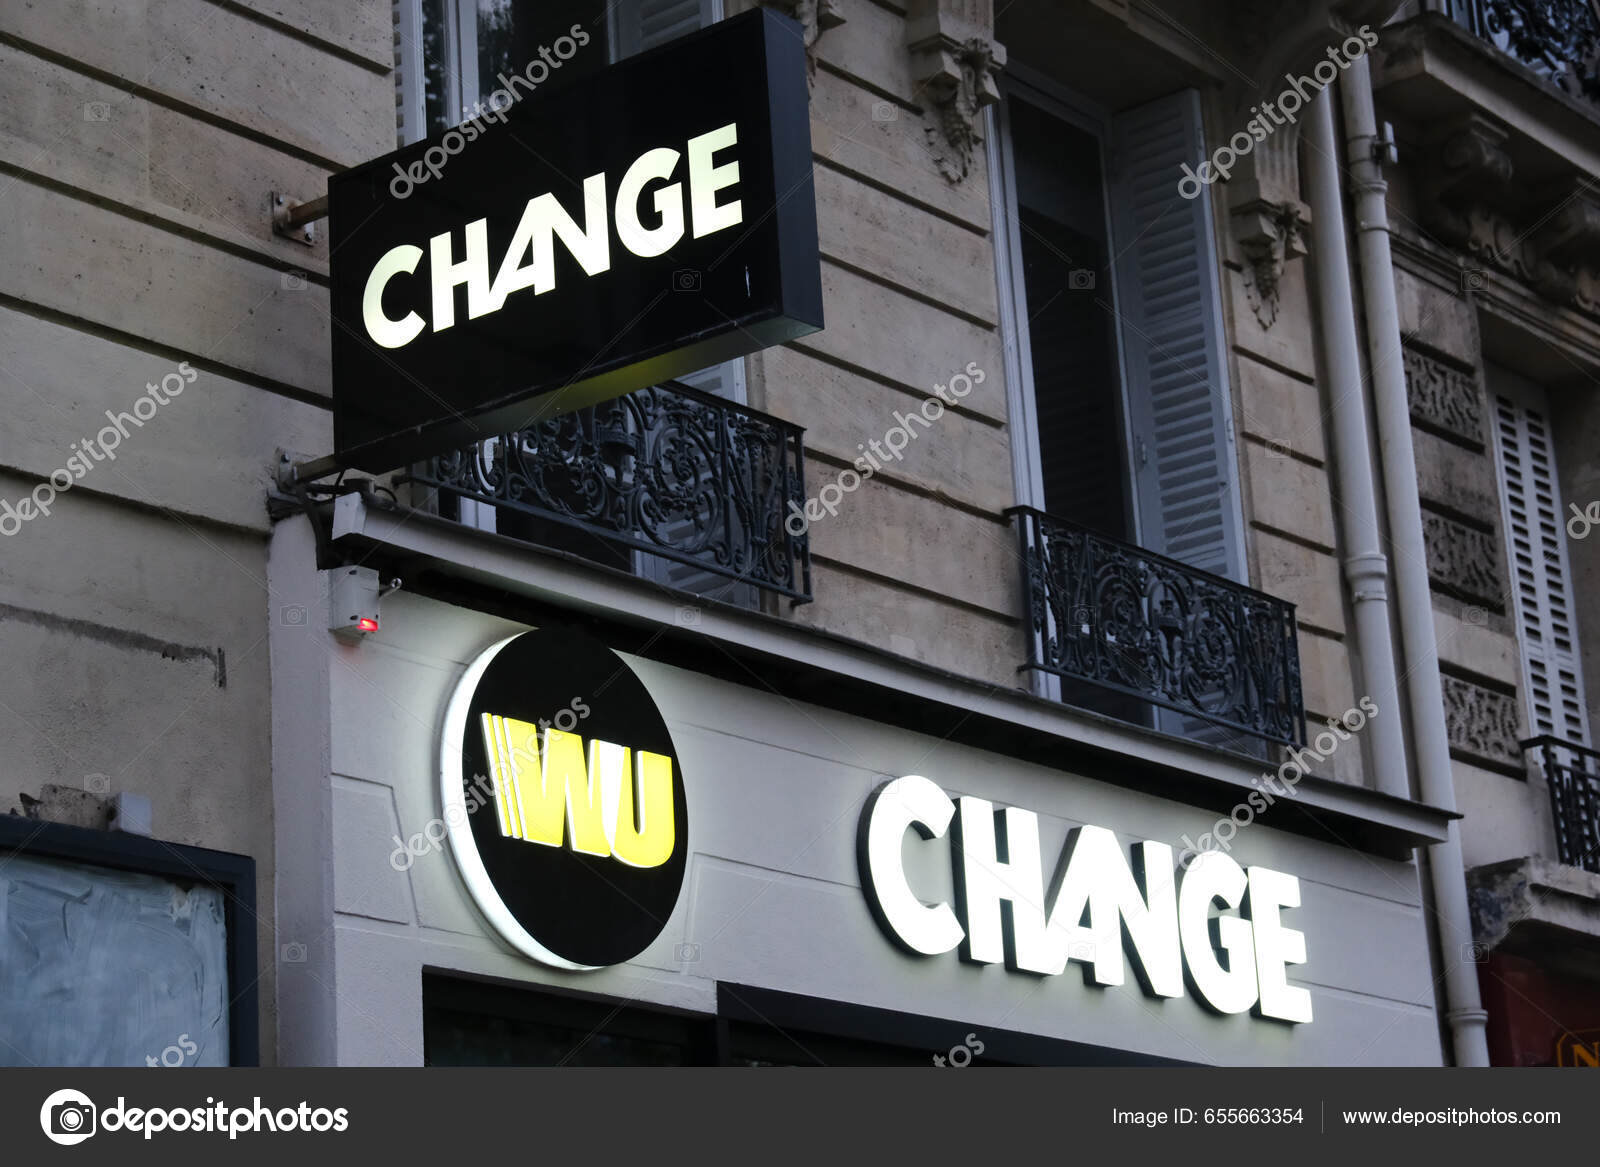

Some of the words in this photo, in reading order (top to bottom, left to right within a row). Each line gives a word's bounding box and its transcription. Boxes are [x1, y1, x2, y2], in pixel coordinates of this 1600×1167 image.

[362, 122, 743, 349] CHANGE
[482, 712, 675, 868] WU
[860, 775, 1313, 1024] CHANGE
